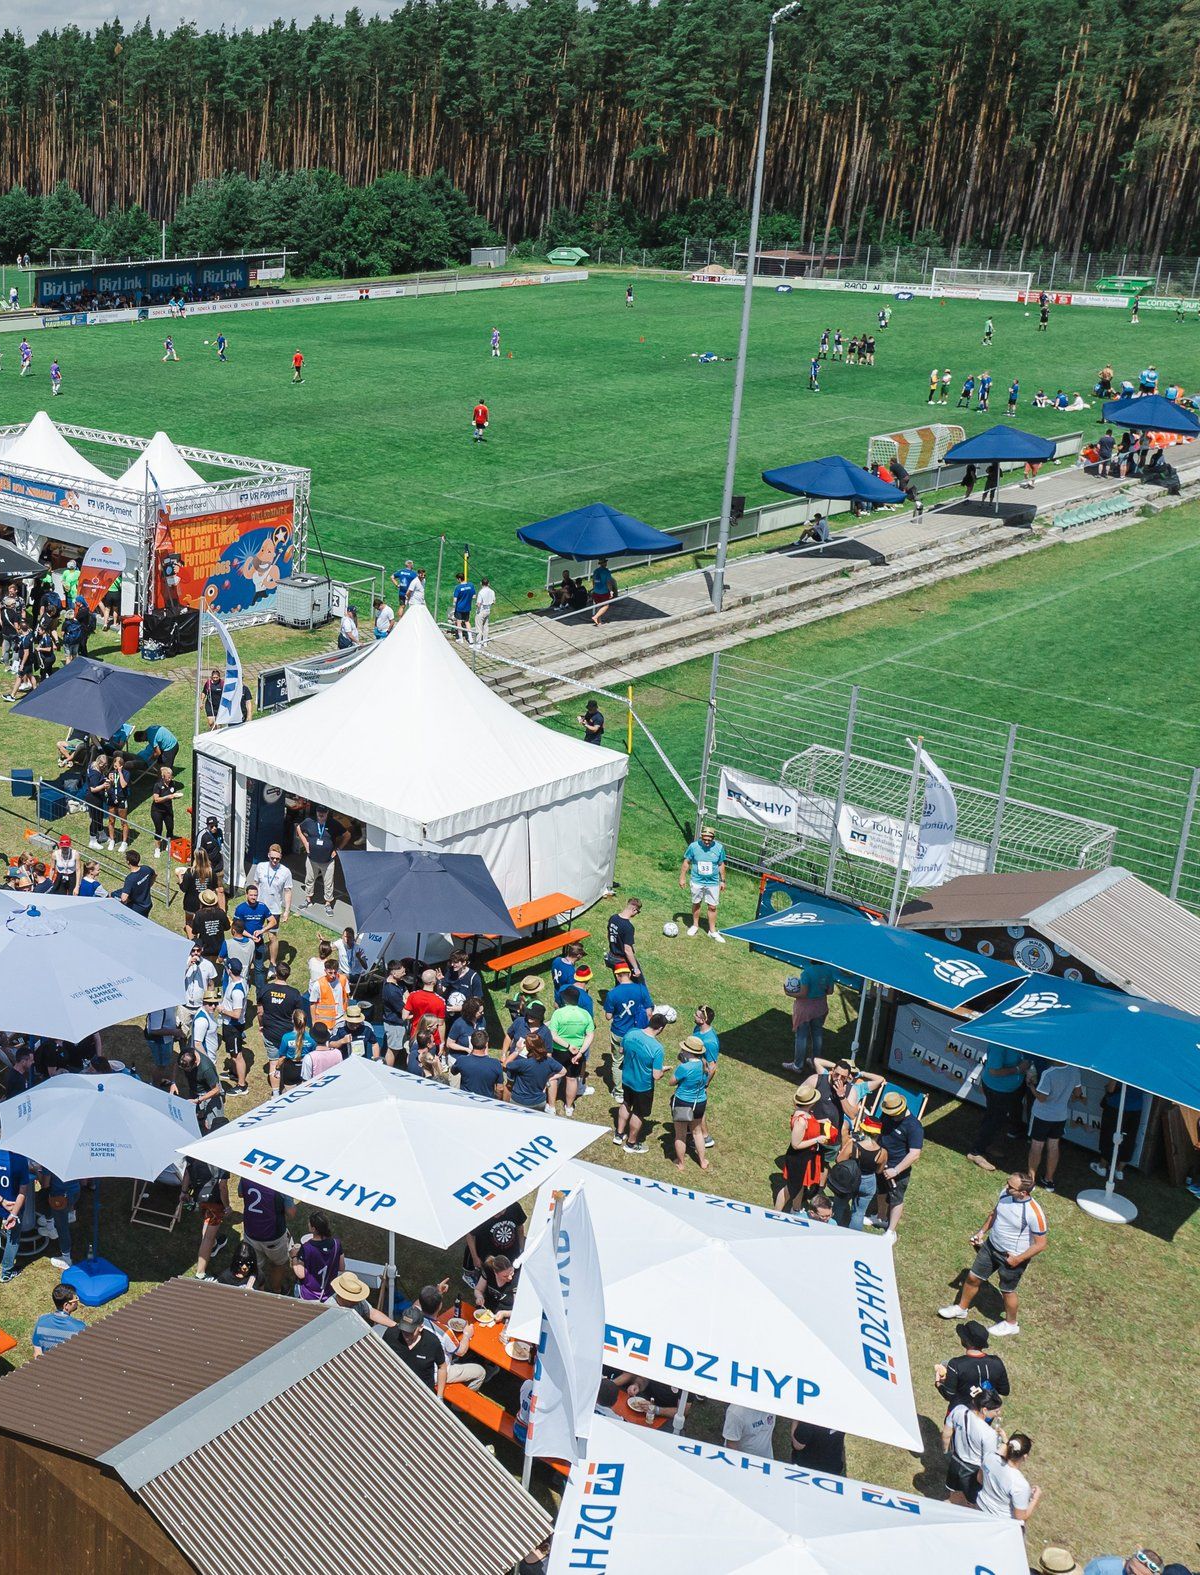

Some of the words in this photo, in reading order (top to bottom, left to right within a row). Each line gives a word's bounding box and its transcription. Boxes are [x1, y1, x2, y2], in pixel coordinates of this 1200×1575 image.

[101, 276, 142, 292] BizLink
[152, 271, 193, 288] BizLink
[203, 268, 243, 284] BizLink
[250, 491, 259, 501] VR
[260, 487, 288, 501] Payment
[96, 500, 105, 510] VR
[105, 502, 133, 518] Payment
[174, 539, 192, 552] HAU
[194, 535, 210, 549] DEN
[184, 549, 221, 567] FOTOBOX
[193, 560, 231, 581] HOTDOGS
[764, 802, 791, 817] HYP
[851, 814, 869, 828] RV
[872, 820, 917, 843] Tourisik
[701, 864, 709, 872] 33
[368, 932, 382, 943] VISA
[89, 987, 118, 1000] KAMMER
[93, 993, 123, 1005] BAYERN
[270, 991, 286, 999] TEAM
[280, 1090, 314, 1105] DZ
[237, 1103, 285, 1128] HYP
[481, 1161, 525, 1191] DZ
[507, 1134, 559, 1173] HYP
[281, 1163, 330, 1192] DZ
[325, 1177, 397, 1212] HYP
[622, 1176, 696, 1201] HYP
[246, 1187, 264, 1214] 2
[704, 1194, 752, 1214] DZ
[316, 1265, 328, 1292] 1
[853, 1260, 888, 1314] HYP
[858, 1308, 892, 1349] DZ
[664, 1342, 719, 1382] DZ
[730, 1360, 821, 1405] HYP
[676, 1444, 771, 1475] HYP
[784, 1466, 844, 1496] DZ
[574, 1504, 617, 1540] DZ
